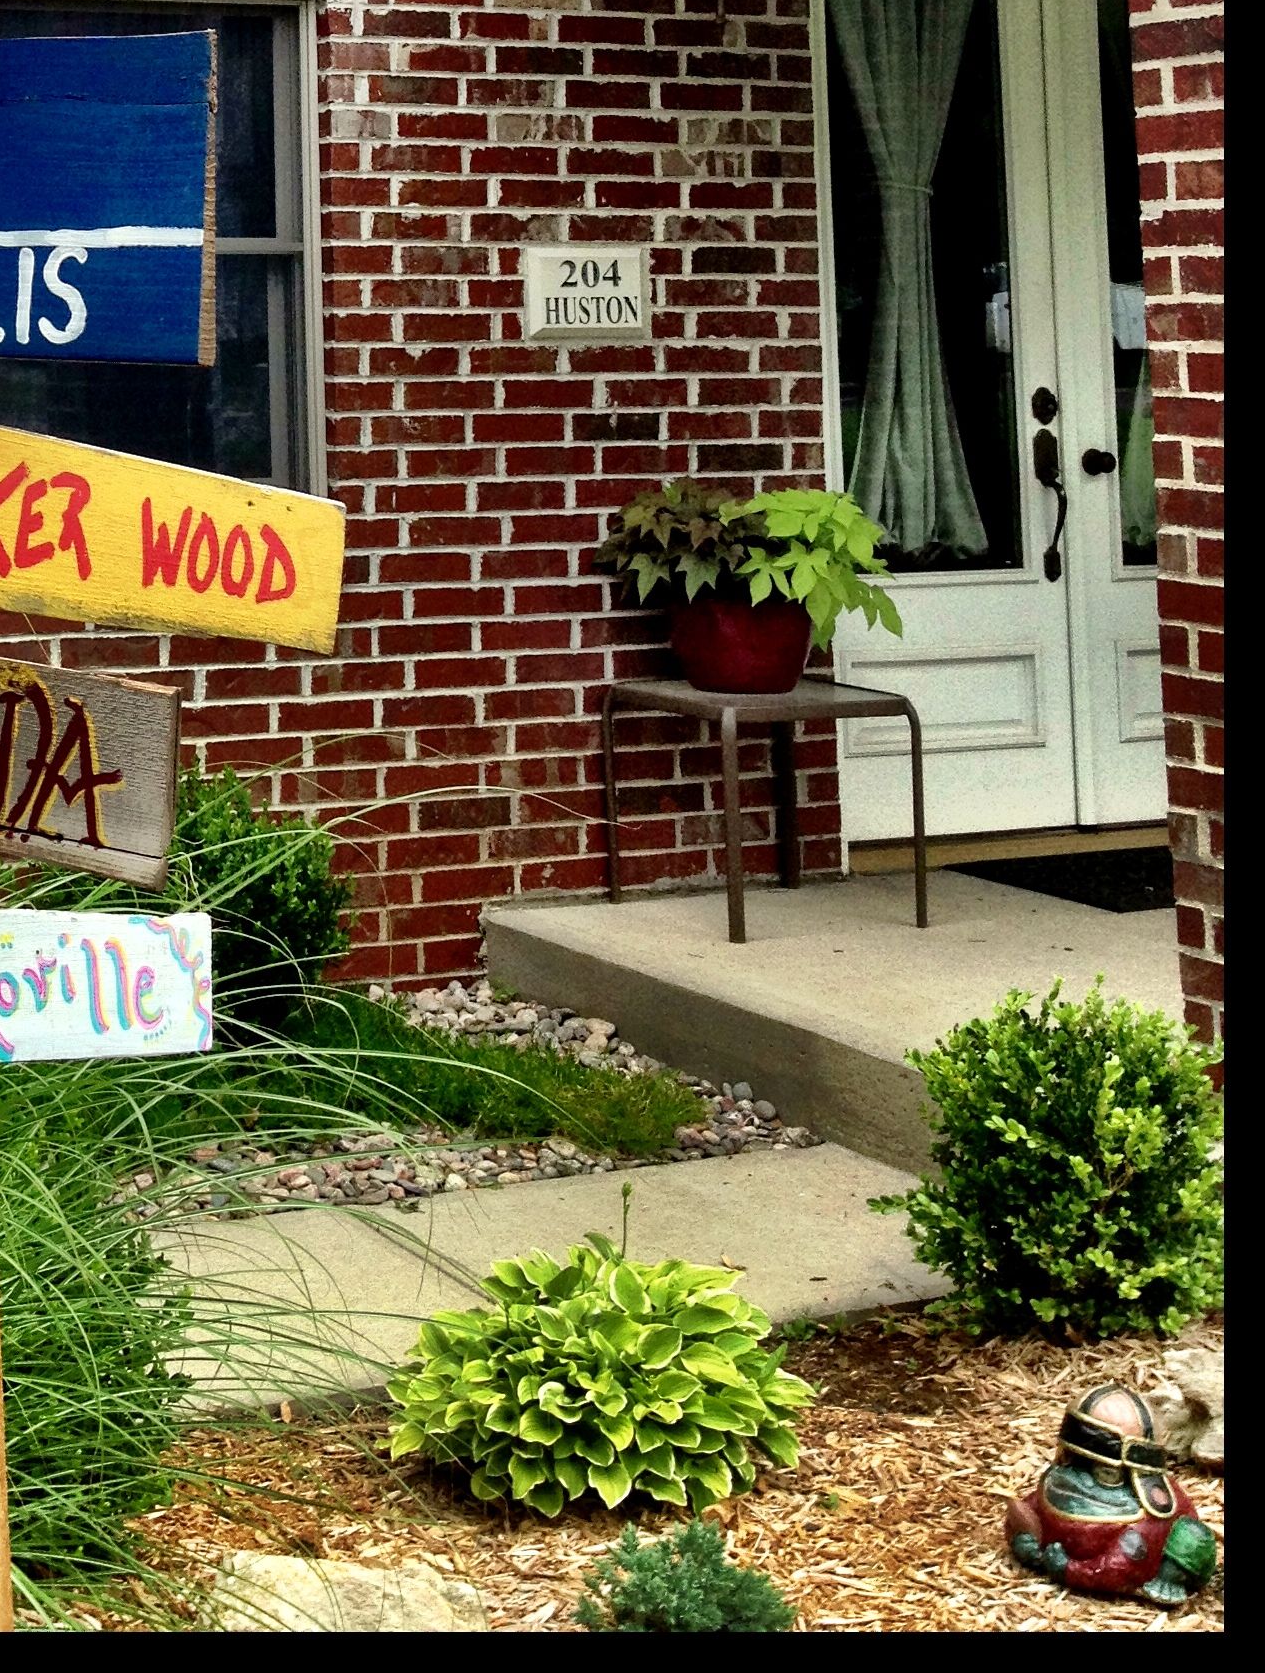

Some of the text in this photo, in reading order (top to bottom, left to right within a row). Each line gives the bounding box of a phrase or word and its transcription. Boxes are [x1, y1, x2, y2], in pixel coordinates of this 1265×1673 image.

[559, 259, 622, 288] 204
[545, 295, 639, 325] HUSTON
[140, 495, 298, 605] WOOD
